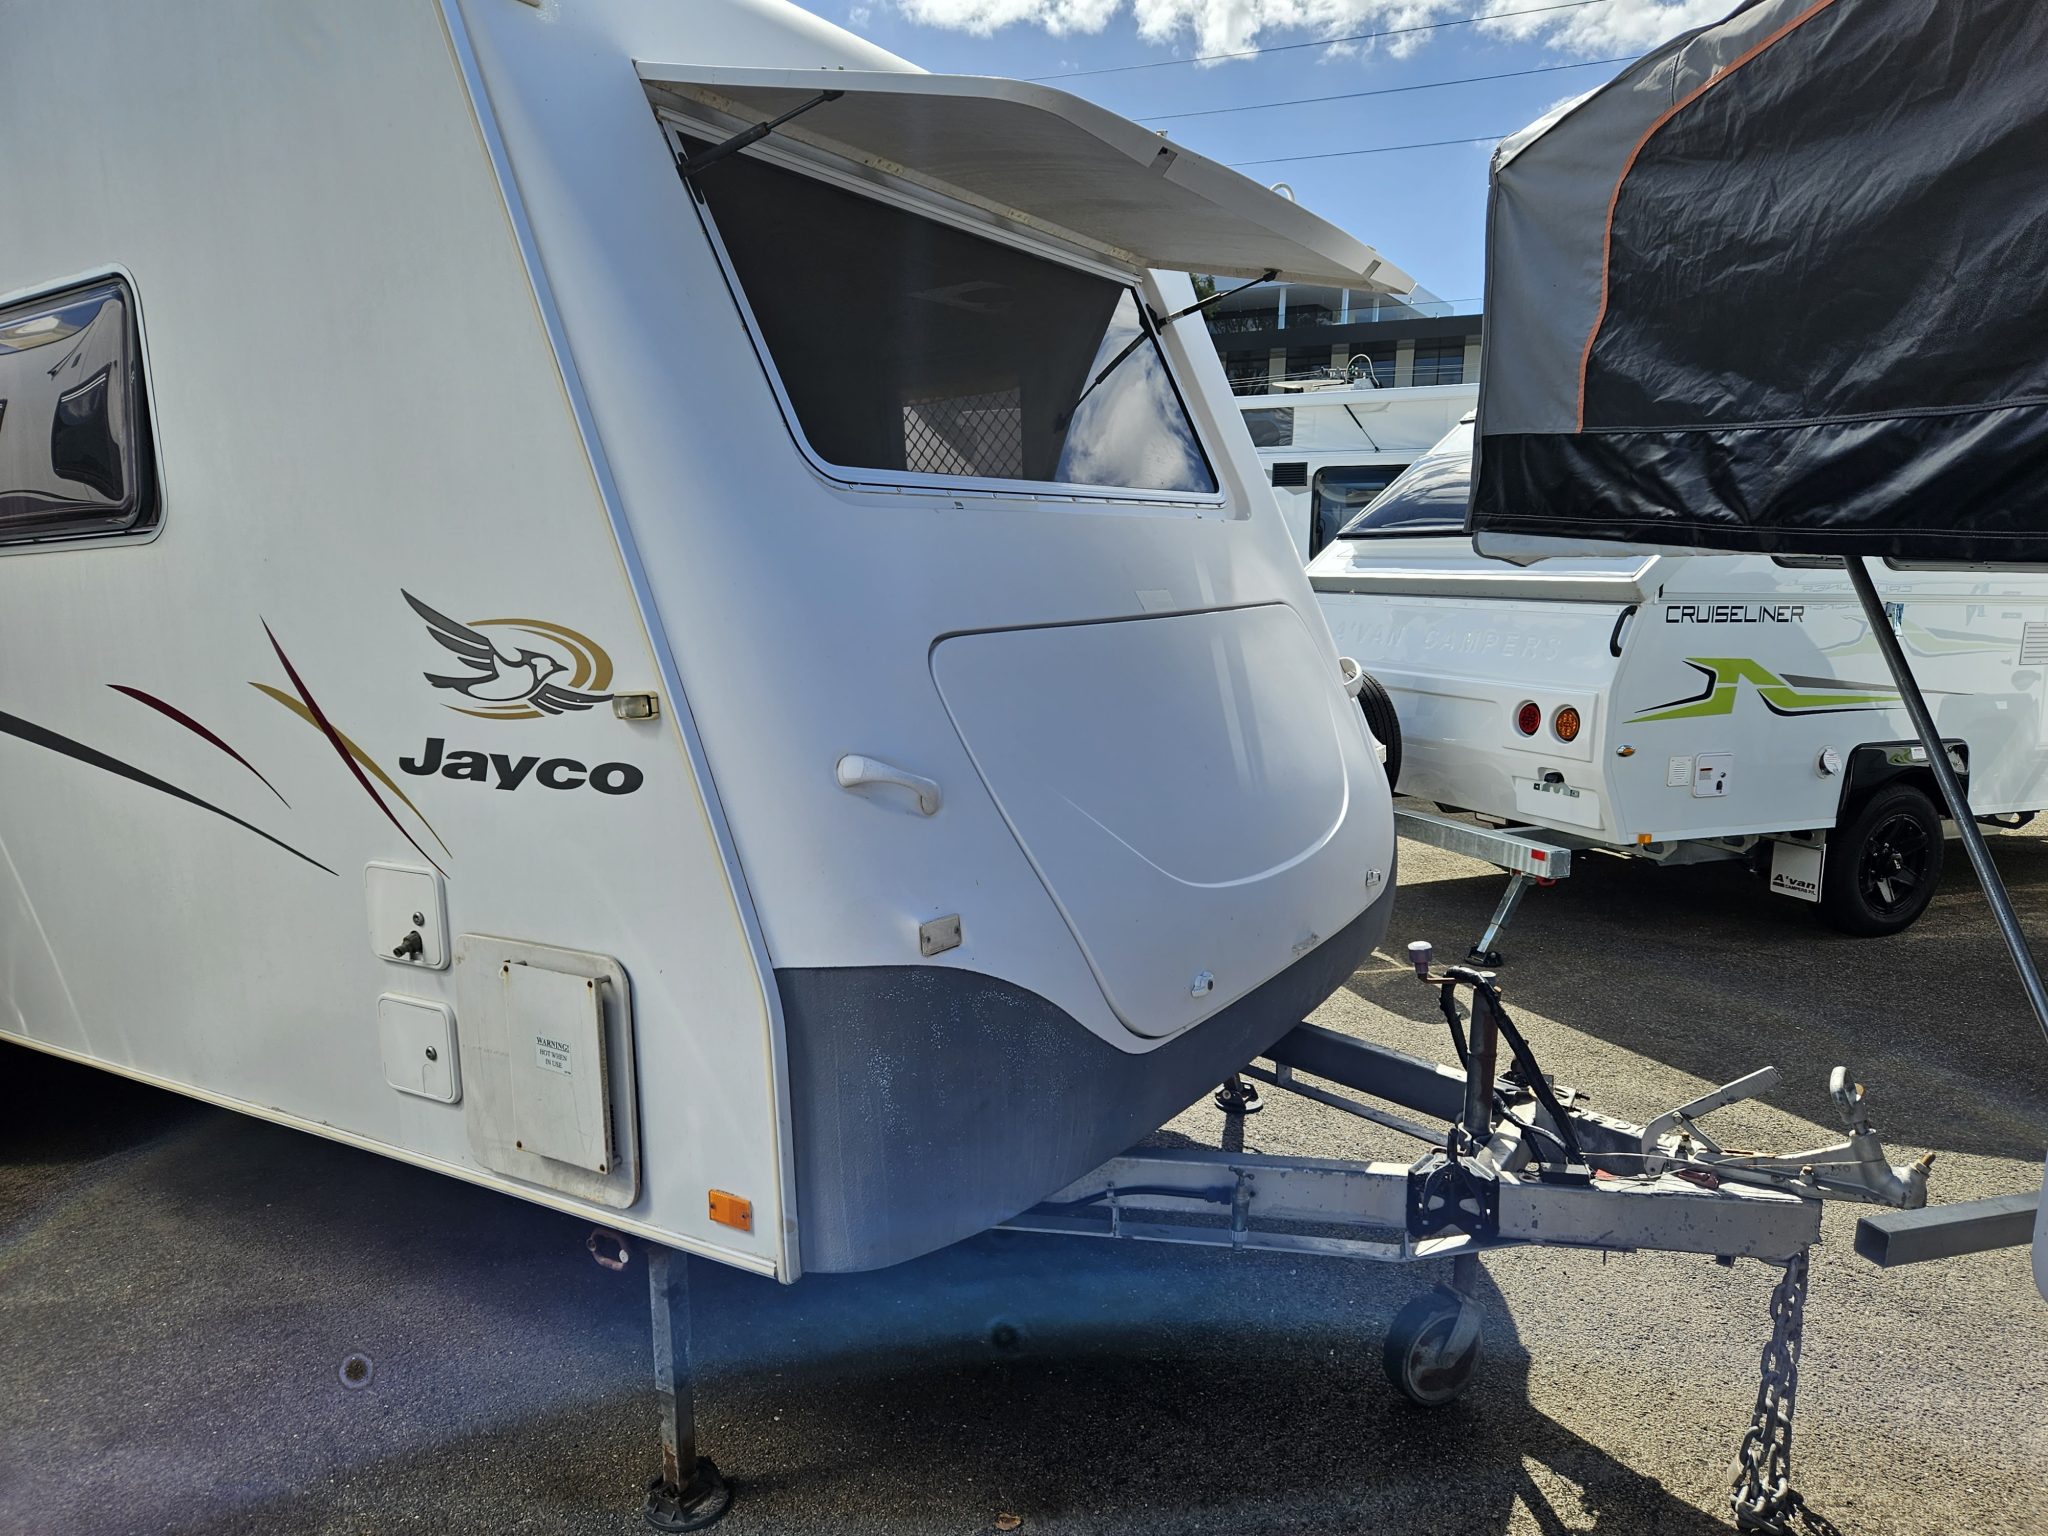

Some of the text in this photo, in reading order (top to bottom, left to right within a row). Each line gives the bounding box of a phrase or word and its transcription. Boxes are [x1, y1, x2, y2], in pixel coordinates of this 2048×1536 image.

[1665, 605, 1804, 623] CRUISELINER
[1424, 628, 1562, 662] CAMPERS
[398, 737, 644, 795] Jayco
[1773, 873, 1816, 890] A'van
[539, 1048, 567, 1061] HOT WHEN
[552, 1060, 563, 1068] USE
